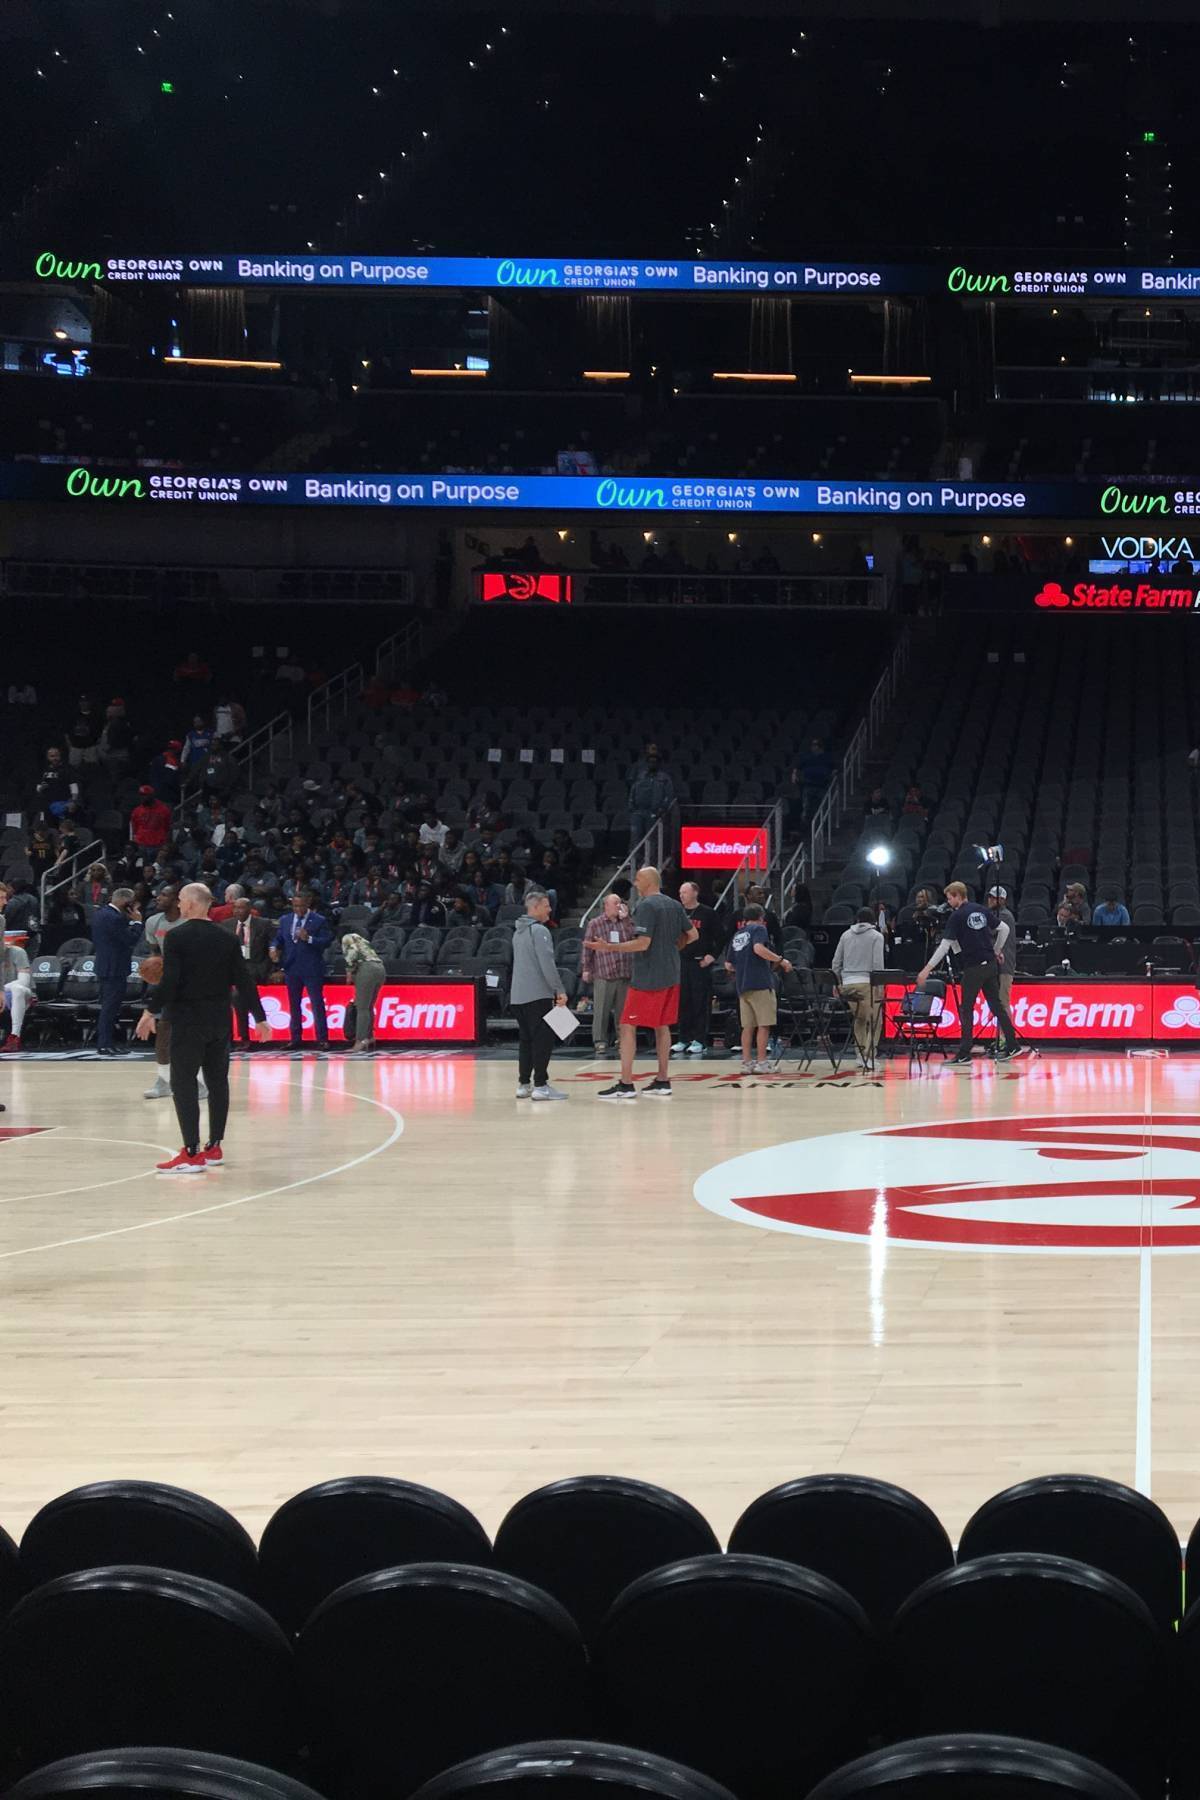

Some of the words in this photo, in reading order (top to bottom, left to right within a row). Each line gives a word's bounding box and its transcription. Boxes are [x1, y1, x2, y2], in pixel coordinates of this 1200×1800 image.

[36, 252, 104, 280] Own
[107, 259, 183, 271] GEORGIA'S
[189, 260, 223, 271] OWN
[238, 260, 315, 282] Banking
[320, 264, 344, 277] on
[351, 262, 429, 282] Purpose
[497, 260, 560, 285] Own
[564, 266, 639, 277] GEORGIA'S
[645, 267, 678, 277] OWN
[107, 272, 145, 280] CREDIT
[147, 273, 181, 281] UNION
[564, 278, 601, 286] CREDIT
[604, 278, 635, 287] UNION
[694, 267, 769, 288] Banking
[774, 272, 797, 284] on
[805, 269, 881, 289] Purpose
[948, 267, 1011, 292] Own
[1015, 273, 1088, 283] GEORGIA'S
[1094, 273, 1126, 283] OWN
[1015, 285, 1051, 293] CREDIT
[1053, 285, 1084, 293] UNION
[66, 467, 146, 498] Own
[150, 475, 241, 489] GEORGIA'S
[248, 478, 288, 491] OWN
[305, 480, 391, 503] Banking
[397, 485, 424, 499] on
[432, 481, 519, 503] Purpose
[596, 479, 668, 508] Own
[672, 485, 756, 498] GEORGIA'S
[763, 486, 800, 498] OWN
[150, 490, 195, 500] CREDIT
[198, 491, 237, 501] UNION
[672, 499, 713, 507] CREDIT
[715, 499, 752, 508] UNION
[817, 487, 900, 509] Banking
[906, 492, 932, 506] on
[941, 488, 1025, 510] Purpose
[1100, 486, 1170, 514] Own
[1101, 537, 1194, 559] VODKA
